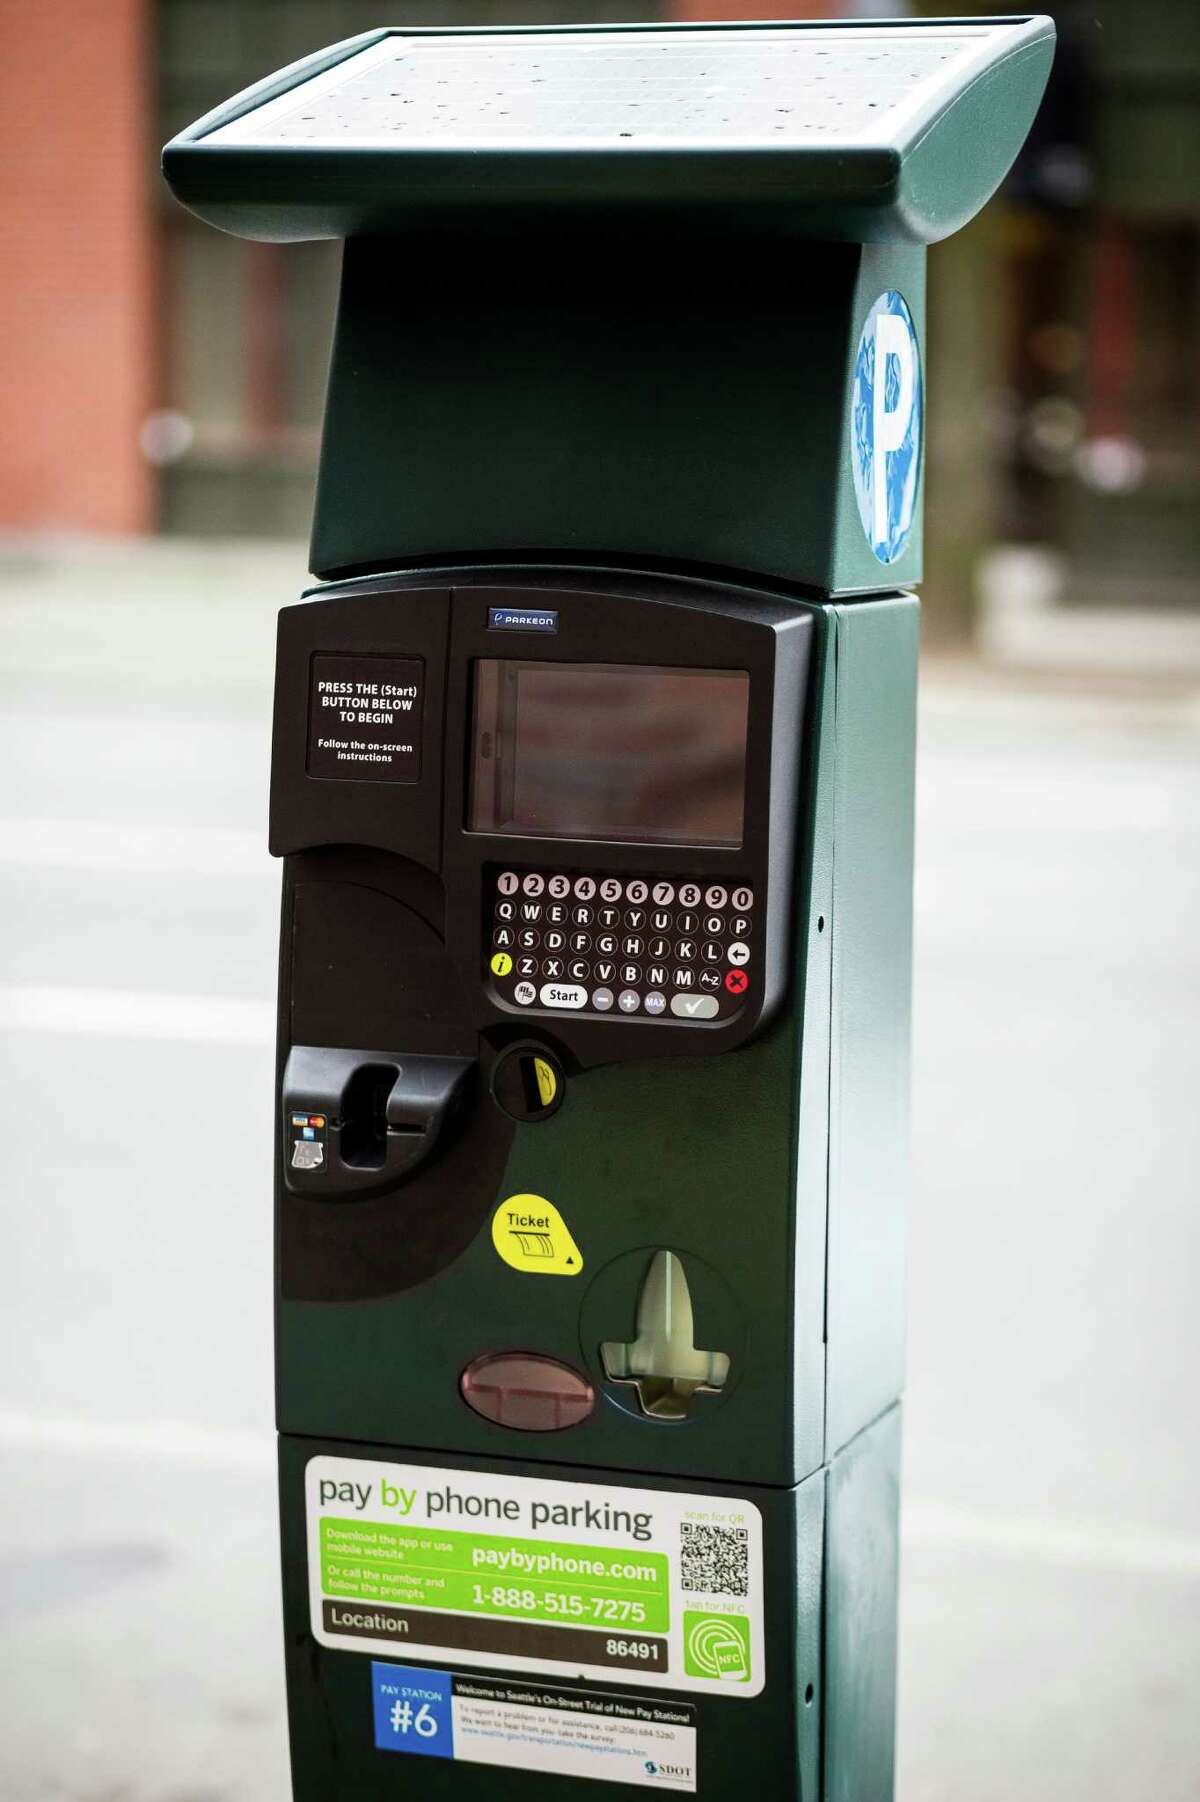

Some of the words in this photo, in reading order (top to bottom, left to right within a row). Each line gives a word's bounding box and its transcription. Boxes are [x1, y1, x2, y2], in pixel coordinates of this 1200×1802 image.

[874, 314, 913, 543] P
[318, 682, 353, 693] PRESS
[356, 683, 378, 695] THE
[381, 685, 417, 698] (Start)
[322, 696, 369, 708] BUTTON
[372, 699, 413, 710] BELOW
[340, 712, 355, 722] TO
[358, 712, 393, 724] BEGIN
[318, 739, 349, 749] Follow
[350, 741, 365, 750] the
[368, 743, 413, 752] on-screen
[337, 751, 392, 762] instructions
[504, 876, 511, 891] 1
[528, 878, 538, 893] 2
[554, 879, 564, 894] 3
[579, 881, 590, 896] 4
[606, 883, 616, 898] 5
[632, 884, 642, 899] 6
[659, 886, 669, 901] 7
[684, 888, 695, 903] 8
[711, 890, 722, 905] 9
[737, 891, 748, 906] 0
[500, 904, 511, 919] Q
[525, 905, 539, 919] W
[552, 907, 561, 921] E
[578, 909, 588, 923] R
[604, 911, 614, 924] T
[630, 912, 640, 926] Y
[656, 914, 667, 928] U
[708, 918, 721, 932] O
[736, 920, 746, 933] P
[498, 930, 508, 944] A
[524, 932, 533, 945] S
[549, 934, 561, 947] D
[577, 936, 586, 949] F
[601, 938, 612, 951] G
[627, 939, 639, 953] H
[655, 942, 663, 955] J
[681, 943, 691, 957] K
[708, 945, 717, 959] L
[522, 959, 532, 973] Z
[548, 961, 558, 975] X
[573, 963, 583, 977] C
[600, 965, 611, 979] V
[626, 967, 636, 981] B
[651, 969, 663, 983] N
[676, 971, 691, 985] M
[549, 989, 579, 1002] Start
[646, 997, 665, 1008] MAX
[507, 1213, 550, 1228] Ticket
[319, 1479, 372, 1510] pay
[381, 1479, 417, 1515] by
[427, 1486, 521, 1521] phone
[531, 1500, 653, 1541] parking
[327, 1527, 377, 1543] Download
[379, 1534, 397, 1545] the
[399, 1538, 418, 1549] app
[420, 1540, 431, 1549] or
[434, 1543, 453, 1552] use
[327, 1543, 361, 1554] mobile
[364, 1548, 404, 1559] website
[328, 1564, 341, 1575] Or
[342, 1567, 361, 1578] call
[363, 1569, 380, 1580] the
[383, 1572, 422, 1585] number
[426, 1578, 446, 1588] and
[472, 1547, 657, 1582] paybyphone.com
[328, 1578, 359, 1591] follow
[361, 1583, 379, 1593] the
[380, 1586, 425, 1600] prompts
[472, 1584, 647, 1623] 1-888-515-7275
[331, 1607, 409, 1633] Location
[606, 1639, 659, 1660] 86491
[719, 1653, 740, 1665] NFC
[381, 1684, 399, 1695] PAY
[401, 1687, 442, 1701] STATION
[456, 1683, 495, 1697] Welcome
[496, 1689, 506, 1699] to
[506, 1690, 542, 1704] Seattle's
[543, 1695, 584, 1709] On-Street
[585, 1700, 604, 1712] Trial
[604, 1702, 614, 1713] of
[615, 1705, 636, 1716] New
[637, 1707, 653, 1721] Pay
[390, 1700, 438, 1737] #6
[659, 1763, 692, 1777] SDOT
